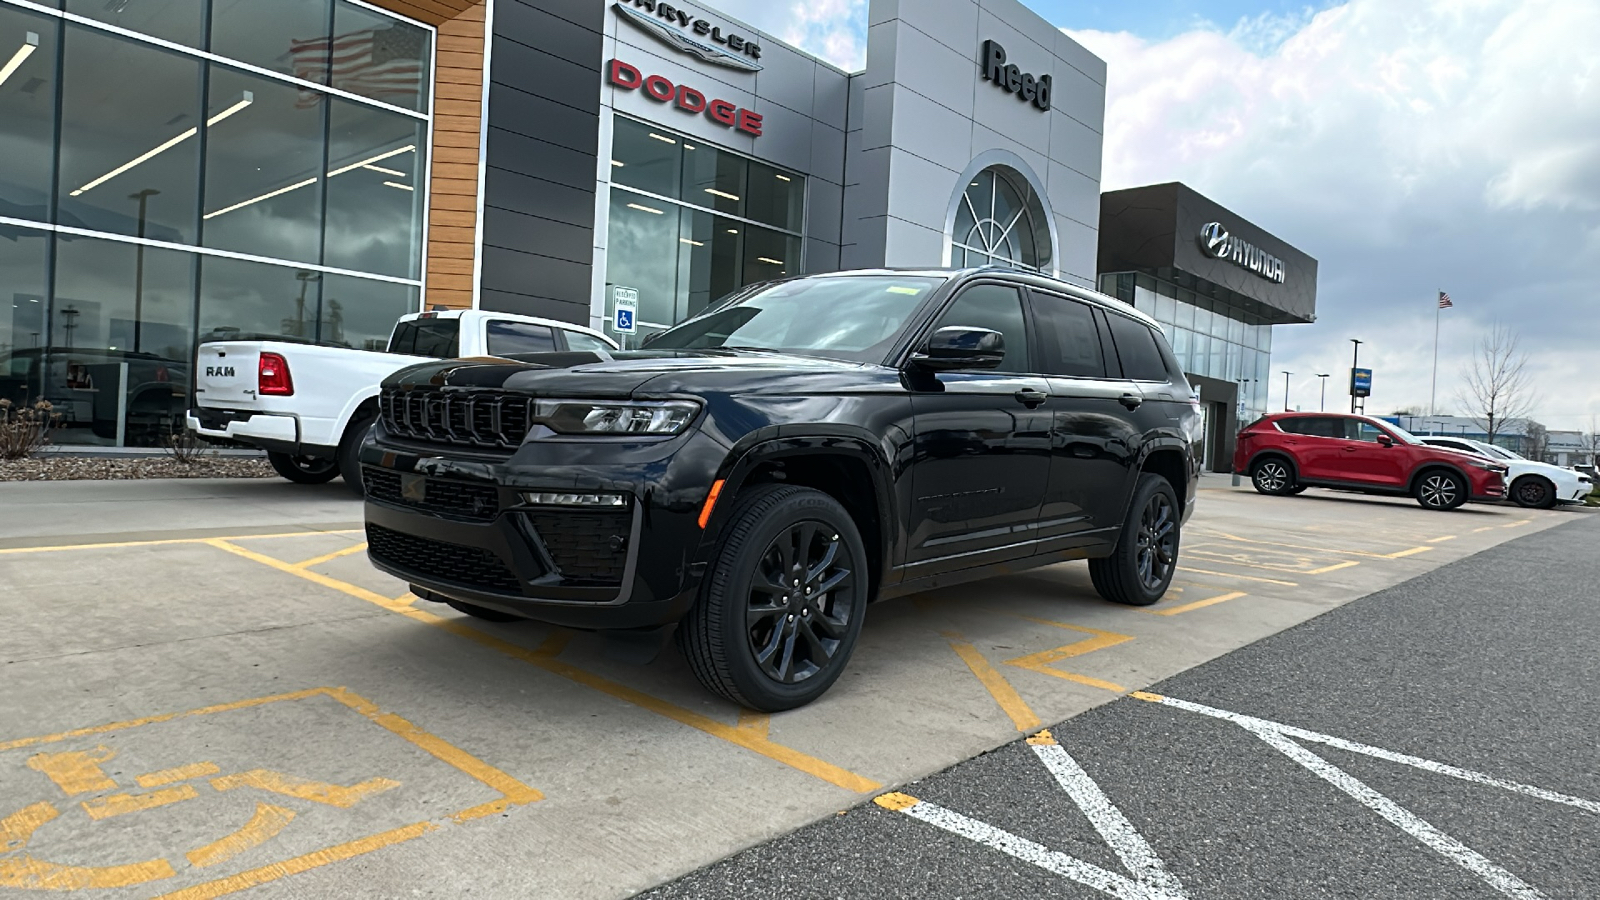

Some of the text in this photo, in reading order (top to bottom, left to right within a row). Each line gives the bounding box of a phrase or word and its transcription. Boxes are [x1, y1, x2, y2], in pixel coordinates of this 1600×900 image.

[619, 0, 761, 58] HRYSLER
[608, 58, 763, 137] DODGE
[983, 39, 1052, 112] Reed
[1231, 236, 1285, 284] HYUNDAI
[616, 298, 636, 307] PARKING
[206, 366, 235, 377] RAM
